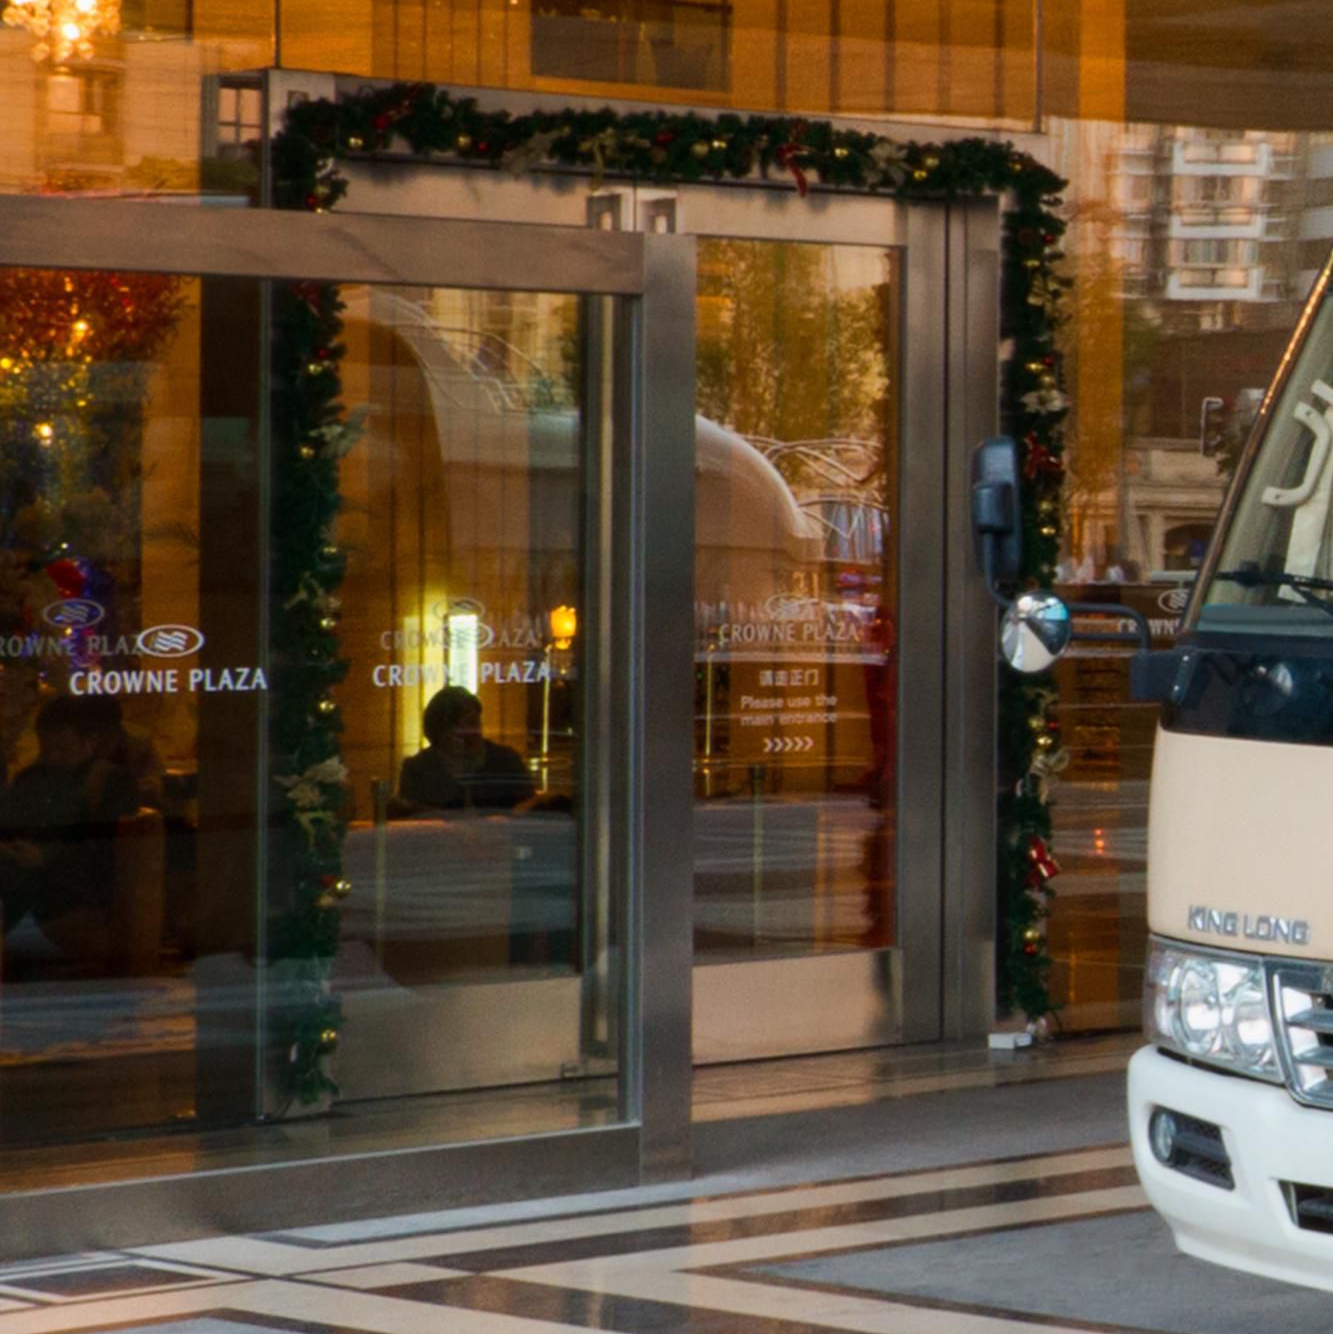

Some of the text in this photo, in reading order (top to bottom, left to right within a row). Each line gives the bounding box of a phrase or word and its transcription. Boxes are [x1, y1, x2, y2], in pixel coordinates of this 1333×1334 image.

[720, 621, 859, 643] CROWNE PLAZA
[69, 667, 268, 695] CROWNE PLAZA
[481, 660, 552, 684] PLAZA
[741, 693, 837, 709] Please use the
[779, 712, 837, 725] entrance
[1187, 904, 1312, 946] KING LONG
